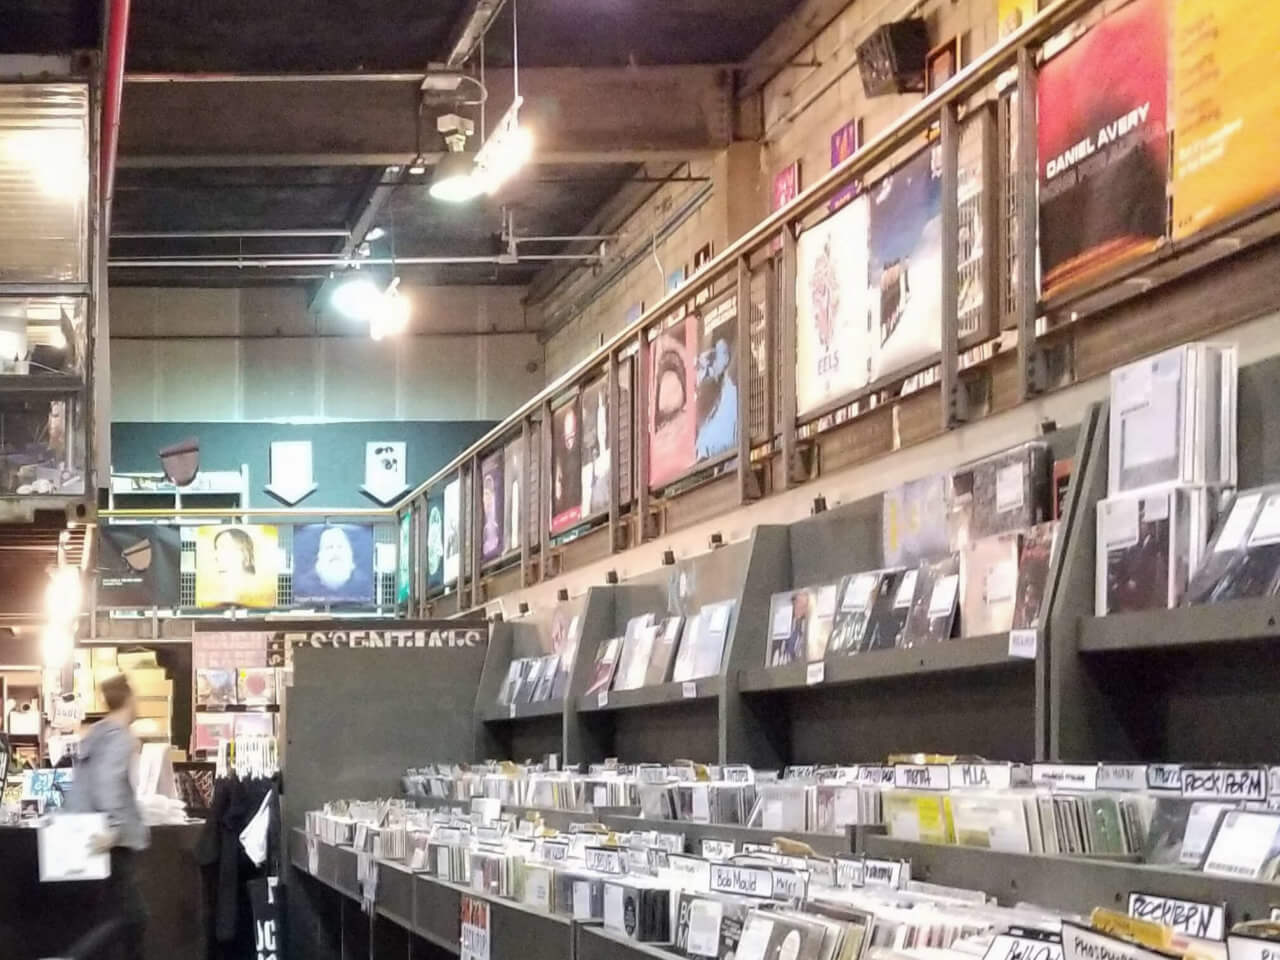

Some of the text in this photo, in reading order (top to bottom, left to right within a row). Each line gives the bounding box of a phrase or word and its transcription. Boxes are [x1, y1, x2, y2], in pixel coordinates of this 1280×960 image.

[1046, 137, 1096, 180] DANIEL
[1097, 100, 1150, 149] AVERY
[817, 350, 840, 376] EELS
[717, 870, 733, 887] Bob
[733, 871, 757, 892] Mould
